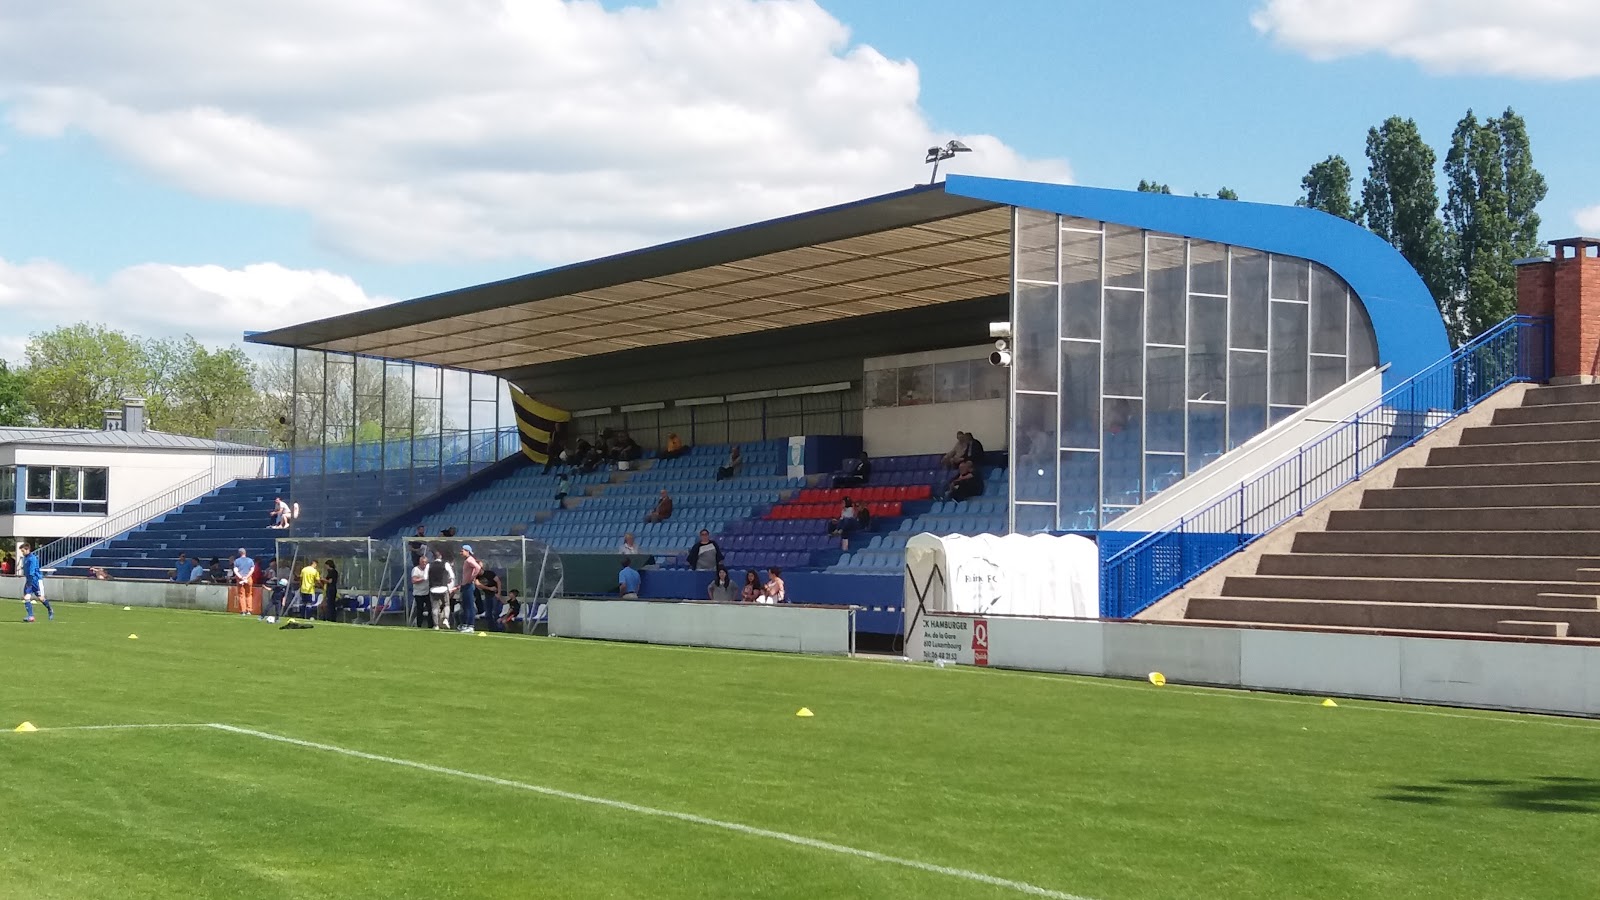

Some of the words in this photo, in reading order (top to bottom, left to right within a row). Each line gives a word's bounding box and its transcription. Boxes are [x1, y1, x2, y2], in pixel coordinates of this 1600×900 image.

[930, 620, 968, 631] HAMBURGER
[944, 632, 957, 640] Gare
[932, 640, 962, 652] Luxembourg
